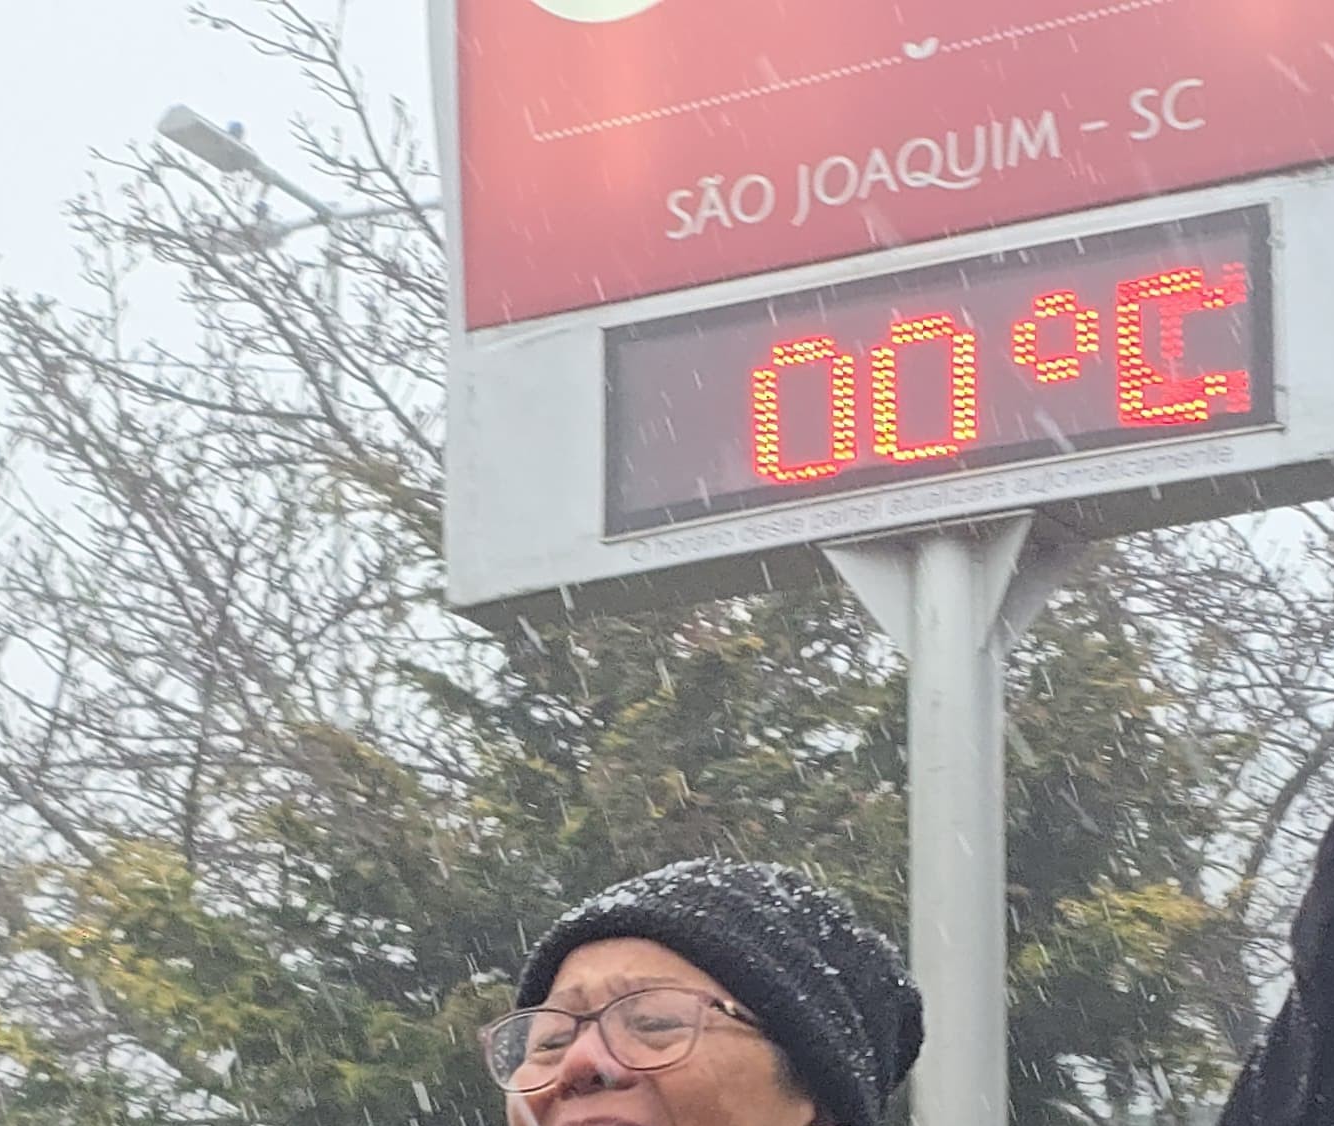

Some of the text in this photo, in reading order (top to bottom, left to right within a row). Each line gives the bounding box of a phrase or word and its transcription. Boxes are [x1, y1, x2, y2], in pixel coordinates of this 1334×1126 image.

[666, 173, 775, 240] SÃO
[790, 110, 1062, 226] JOAQUIM
[1129, 78, 1205, 141] SC
